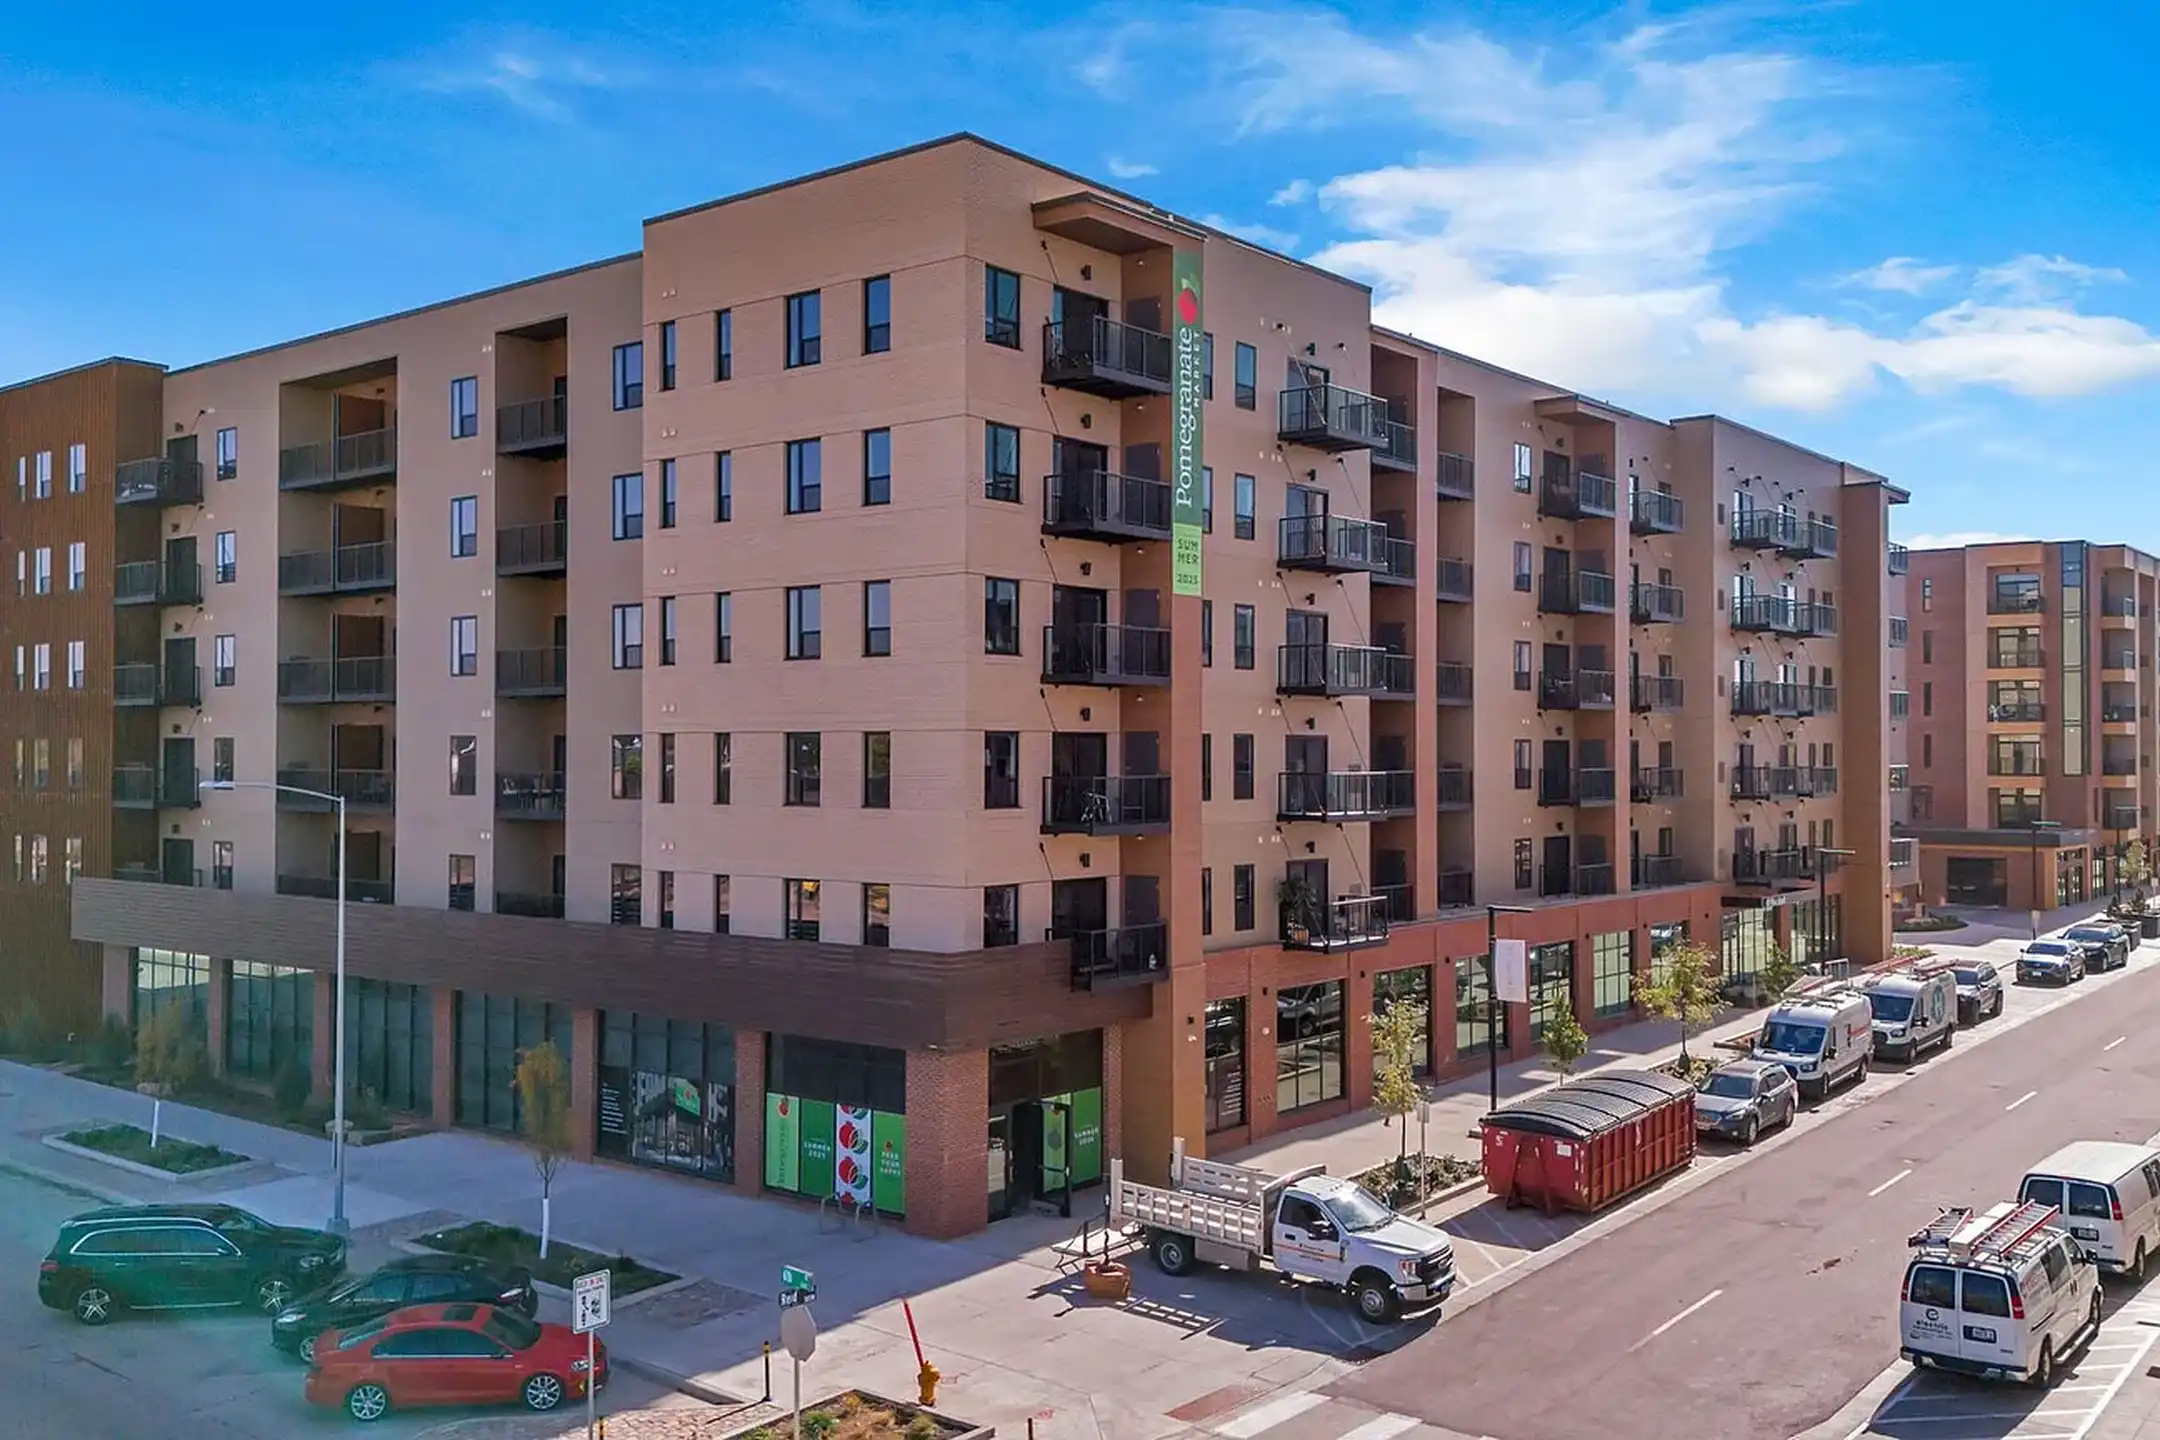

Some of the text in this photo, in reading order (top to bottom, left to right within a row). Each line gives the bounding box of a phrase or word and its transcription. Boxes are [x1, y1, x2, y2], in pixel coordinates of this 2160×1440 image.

[1193, 331, 1201, 408] MARKET
[1176, 327, 1197, 508] Pomegranate
[1178, 538, 1199, 550] SUM
[1178, 552, 1199, 565] MER
